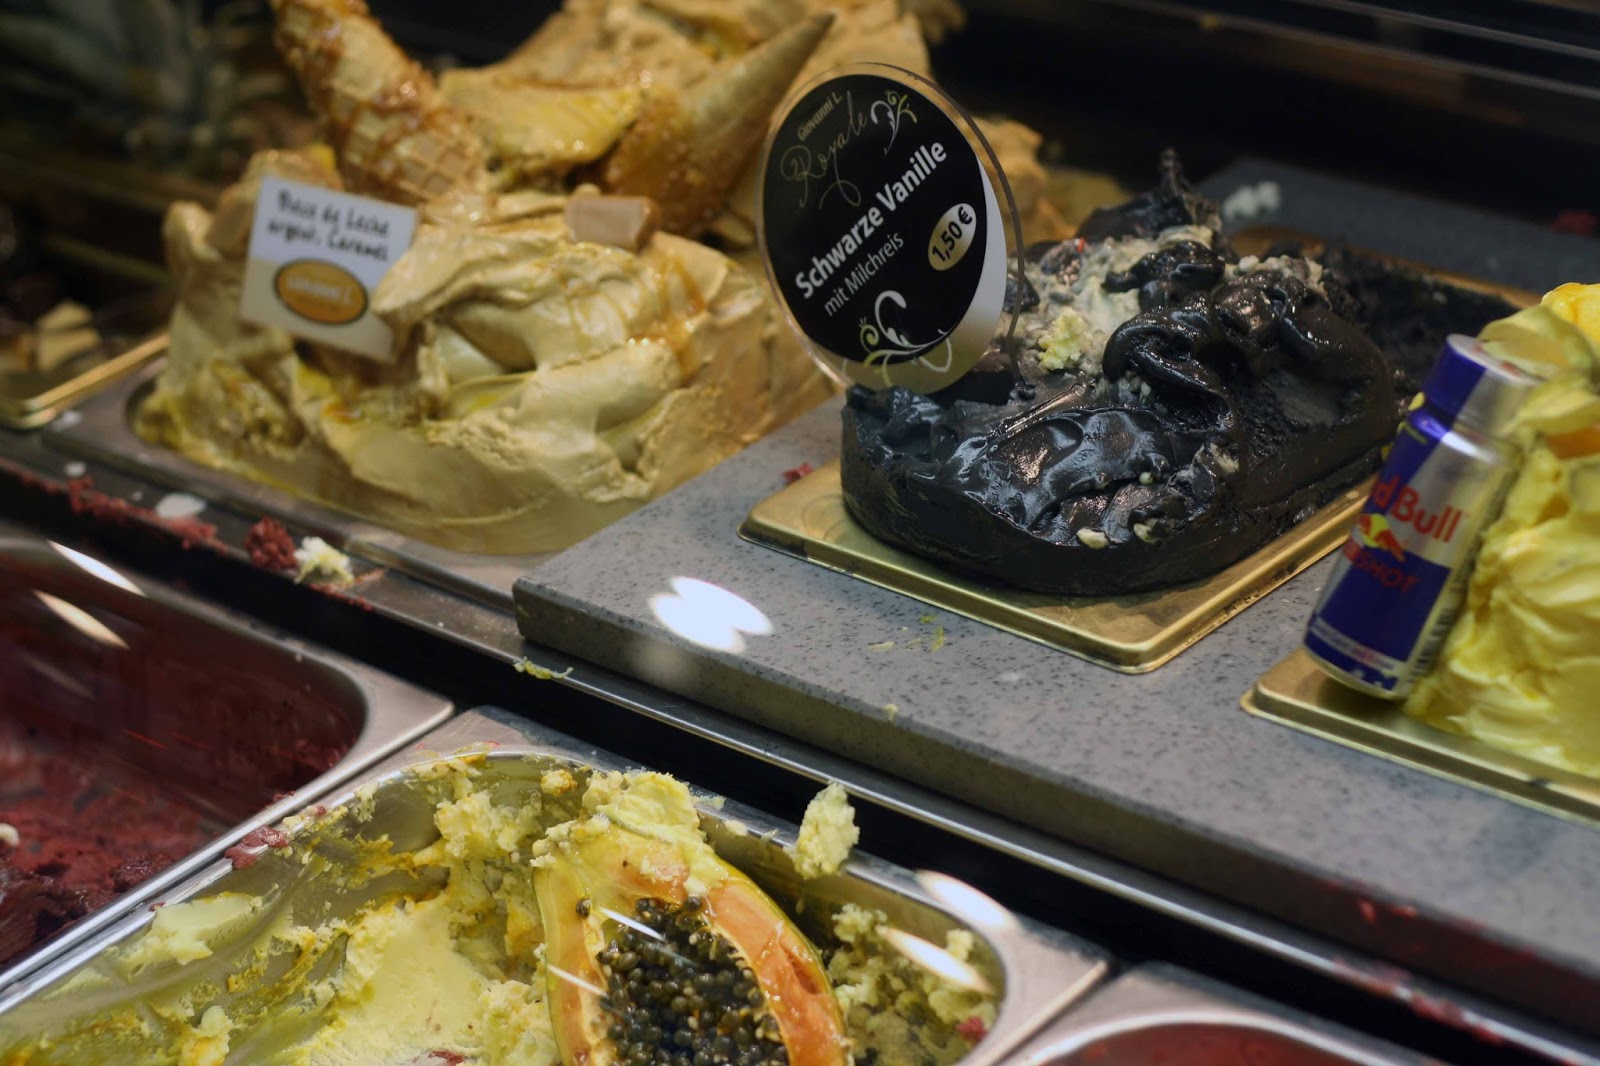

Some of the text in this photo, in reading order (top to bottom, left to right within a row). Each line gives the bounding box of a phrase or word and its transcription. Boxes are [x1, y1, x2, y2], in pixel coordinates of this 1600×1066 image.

[781, 90, 868, 212] Royale
[796, 142, 947, 298] Schwarze Vanille
[824, 231, 904, 316] mit Milchreis
[1391, 485, 1463, 543] Bull
